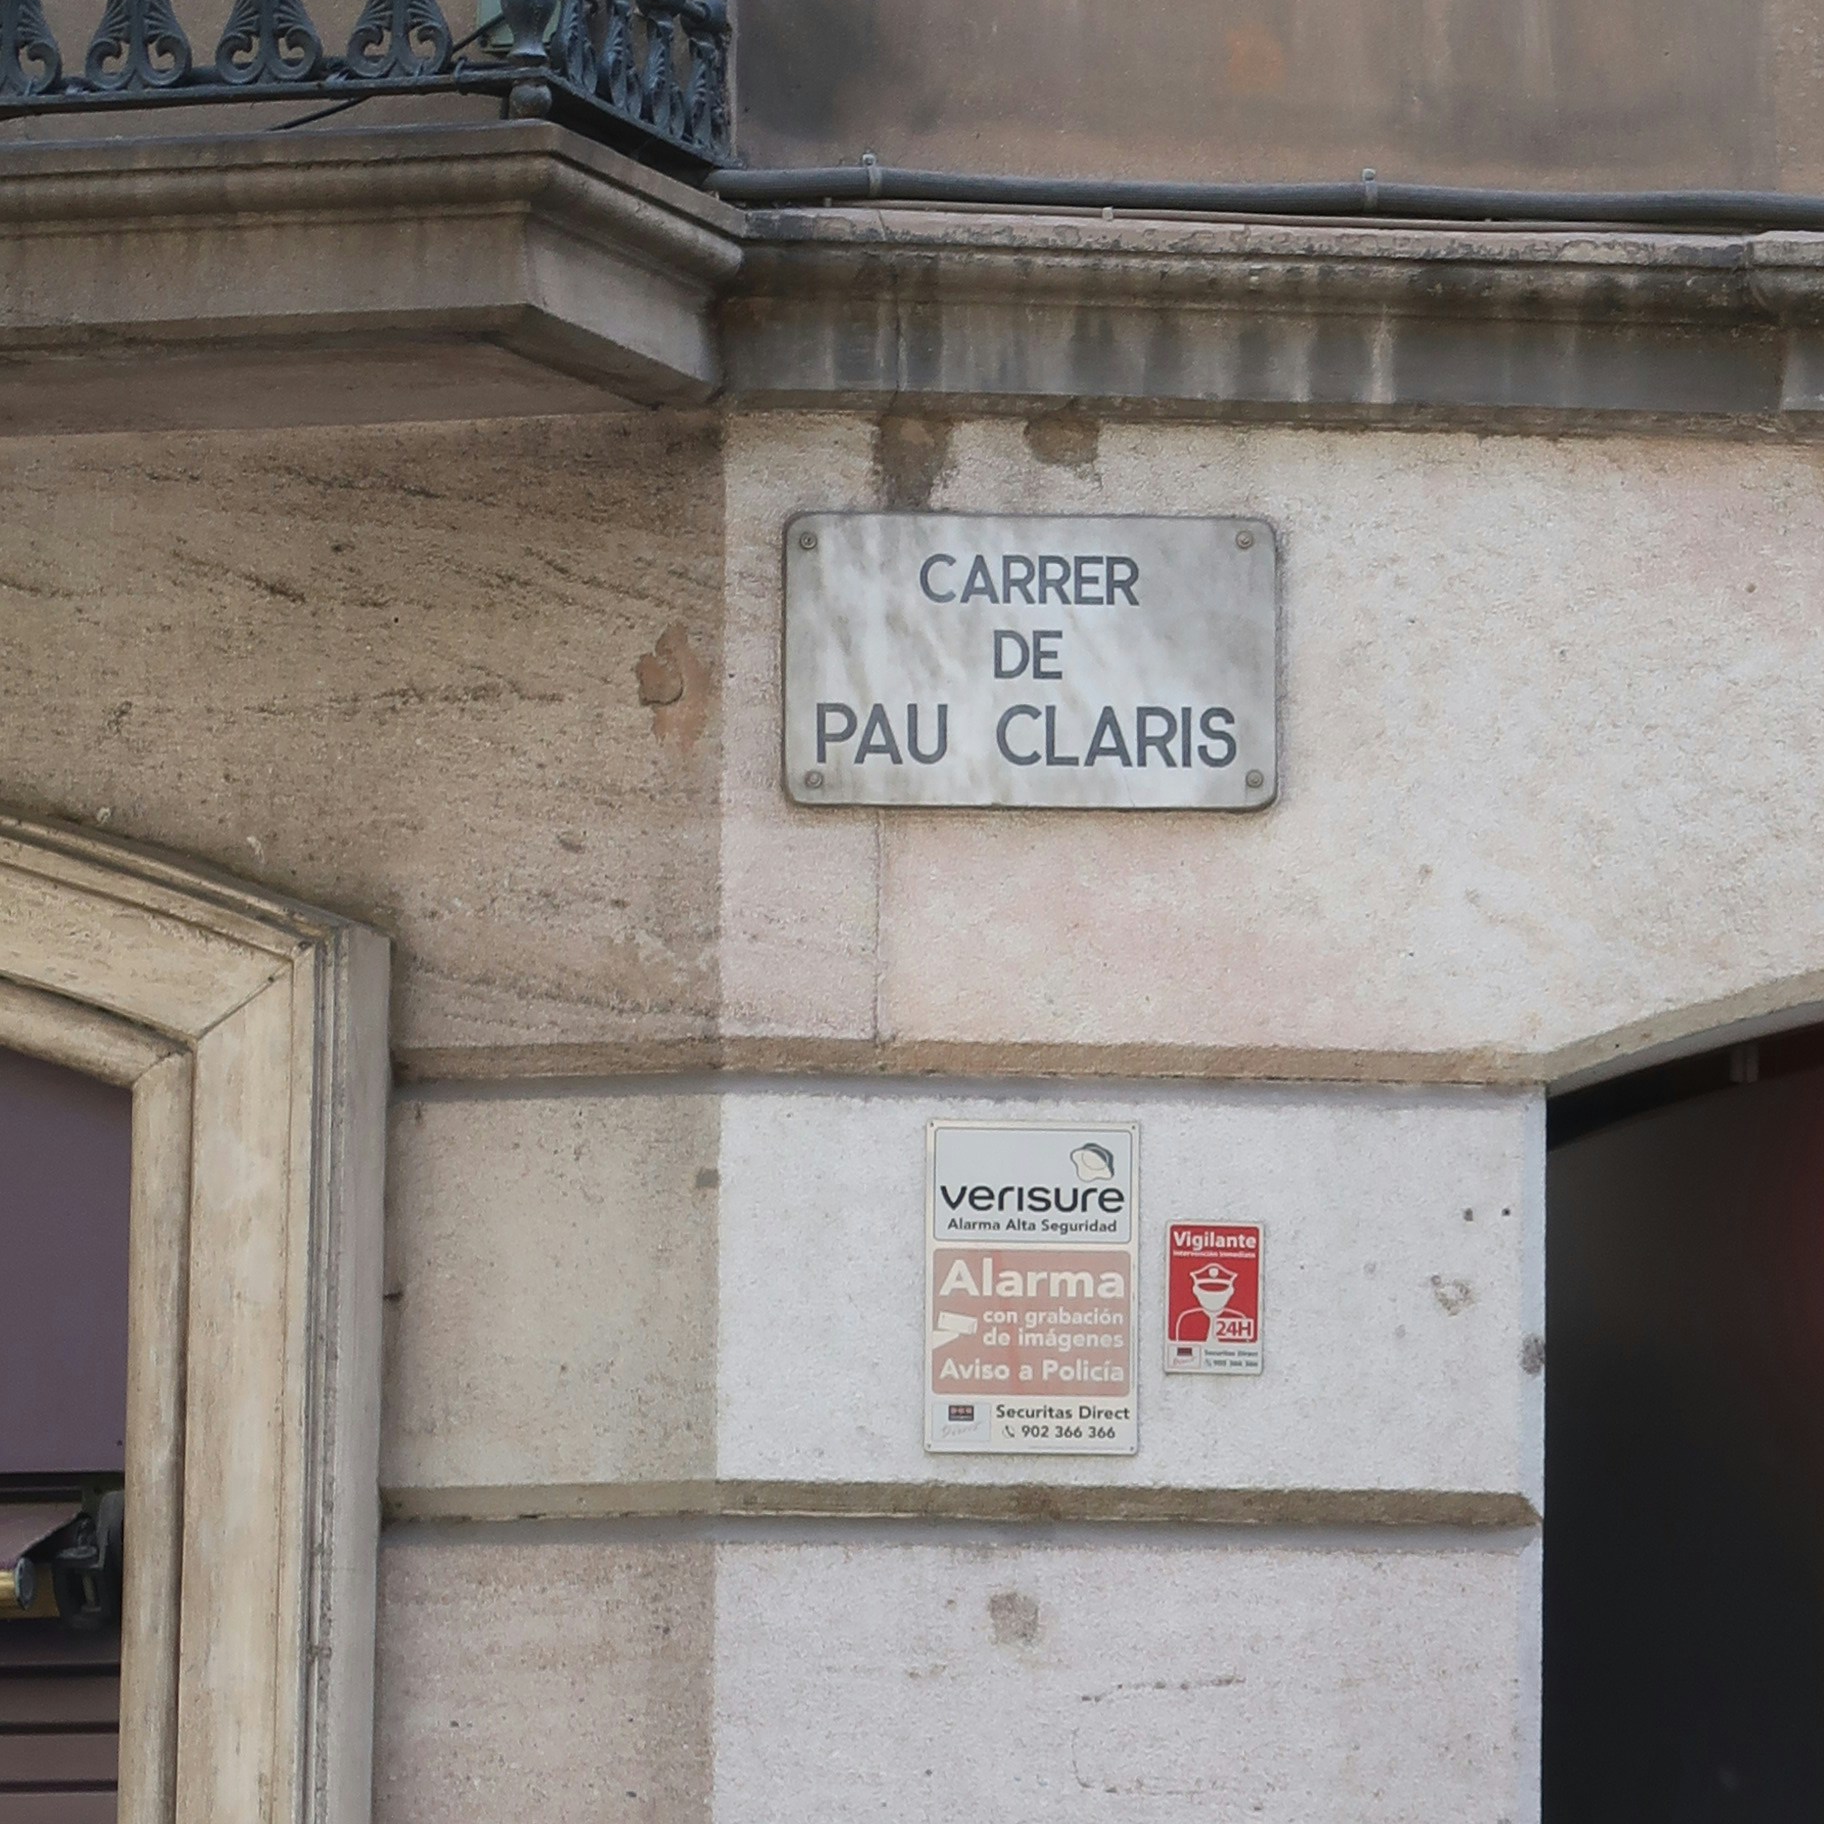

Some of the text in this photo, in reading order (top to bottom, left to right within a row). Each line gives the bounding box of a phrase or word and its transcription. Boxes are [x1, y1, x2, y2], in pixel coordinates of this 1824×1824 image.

[919, 553, 1140, 606] CARRER
[993, 629, 1064, 680] DE
[815, 702, 1237, 769] PAU CLARIS
[940, 1185, 1125, 1214] verisure
[947, 1218, 1117, 1236] Alarma Alta Seguridad
[1173, 1231, 1257, 1251] Vigilante
[939, 1257, 1125, 1299] Alarma
[982, 1306, 1124, 1328] con grabación
[1216, 1320, 1252, 1338] 24H
[982, 1327, 1124, 1352] de imágenes
[939, 1357, 1124, 1382] Aviso a Policía
[996, 1404, 1130, 1420] Securitas Direct
[1021, 1425, 1116, 1439] 902 366 366
